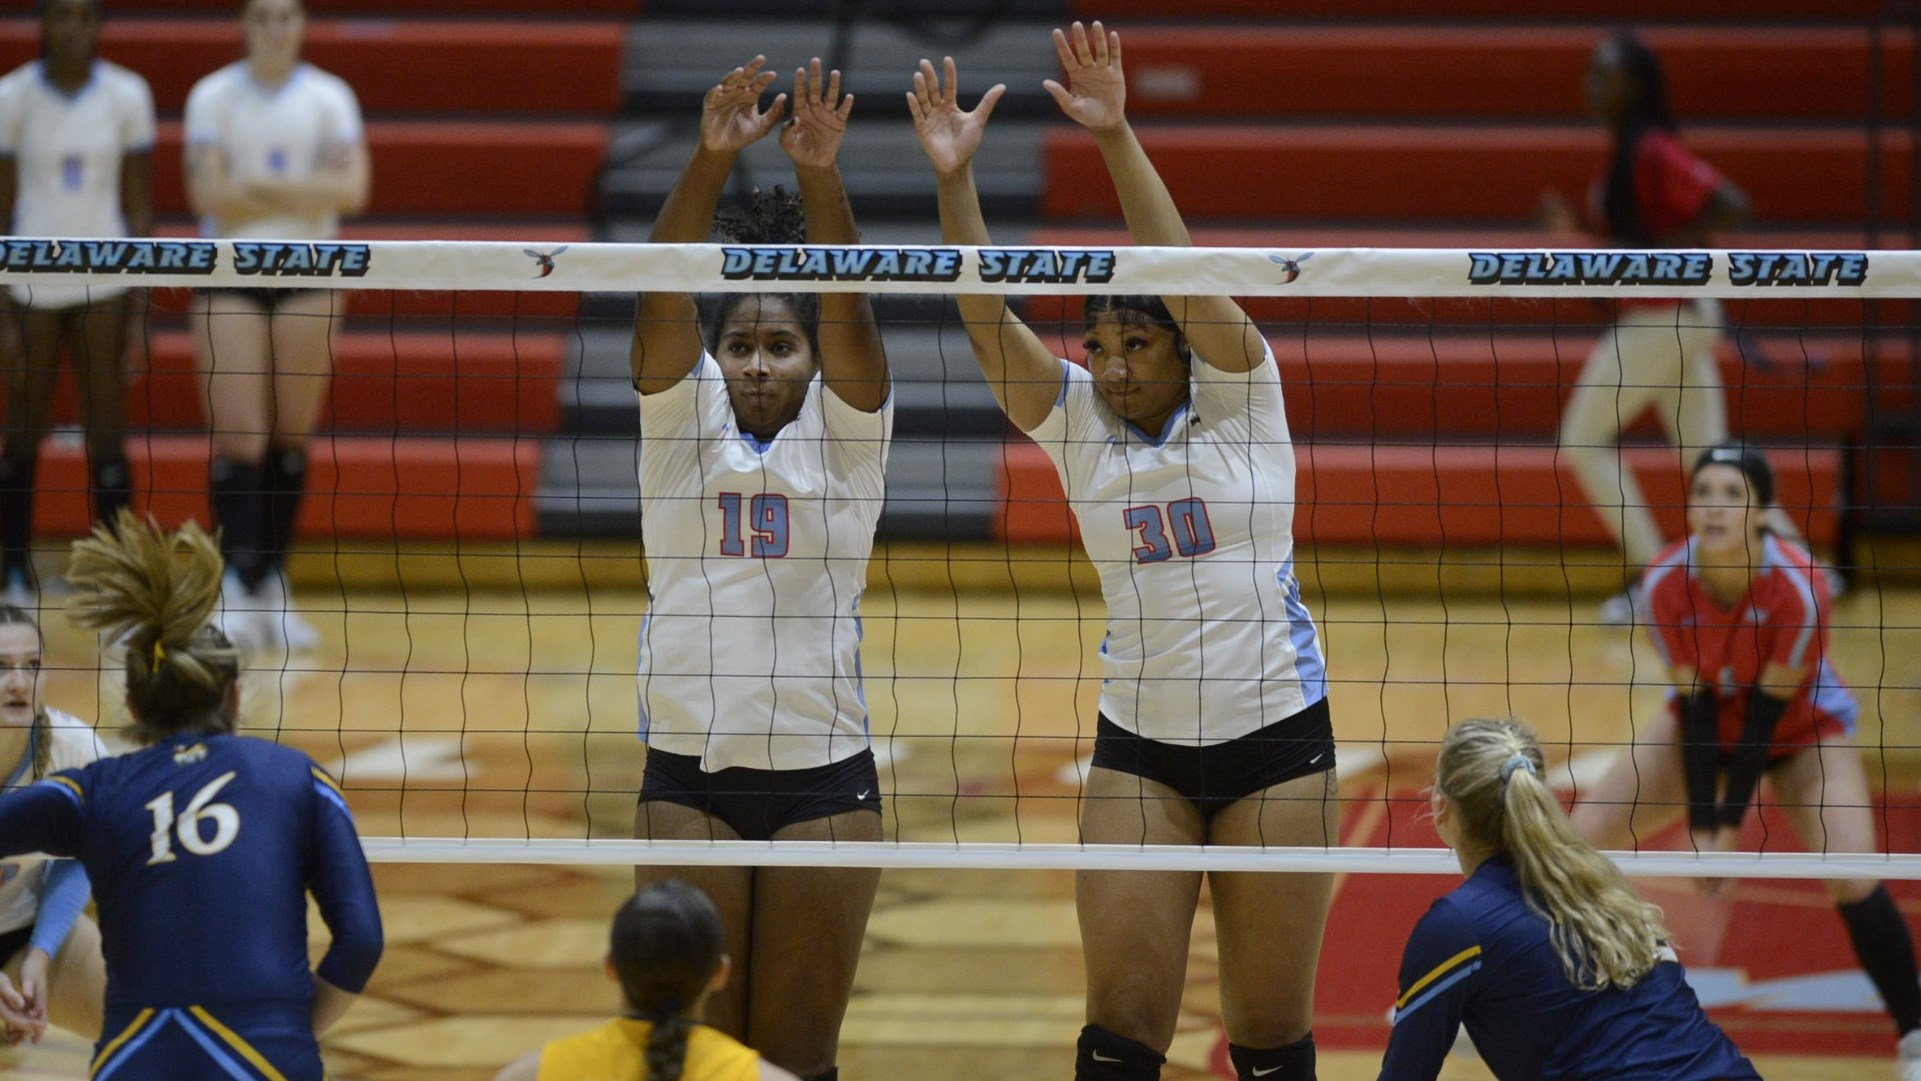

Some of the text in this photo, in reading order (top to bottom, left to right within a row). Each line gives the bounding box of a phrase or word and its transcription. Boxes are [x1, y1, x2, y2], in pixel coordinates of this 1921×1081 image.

[0, 240, 371, 276] ELAWARE STATE
[721, 248, 1116, 283] DELAWARE STATE
[1468, 253, 1869, 286] DELAWARE STATE
[718, 492, 789, 558] 19
[1122, 497, 1216, 565] 30
[144, 770, 240, 867] 16
